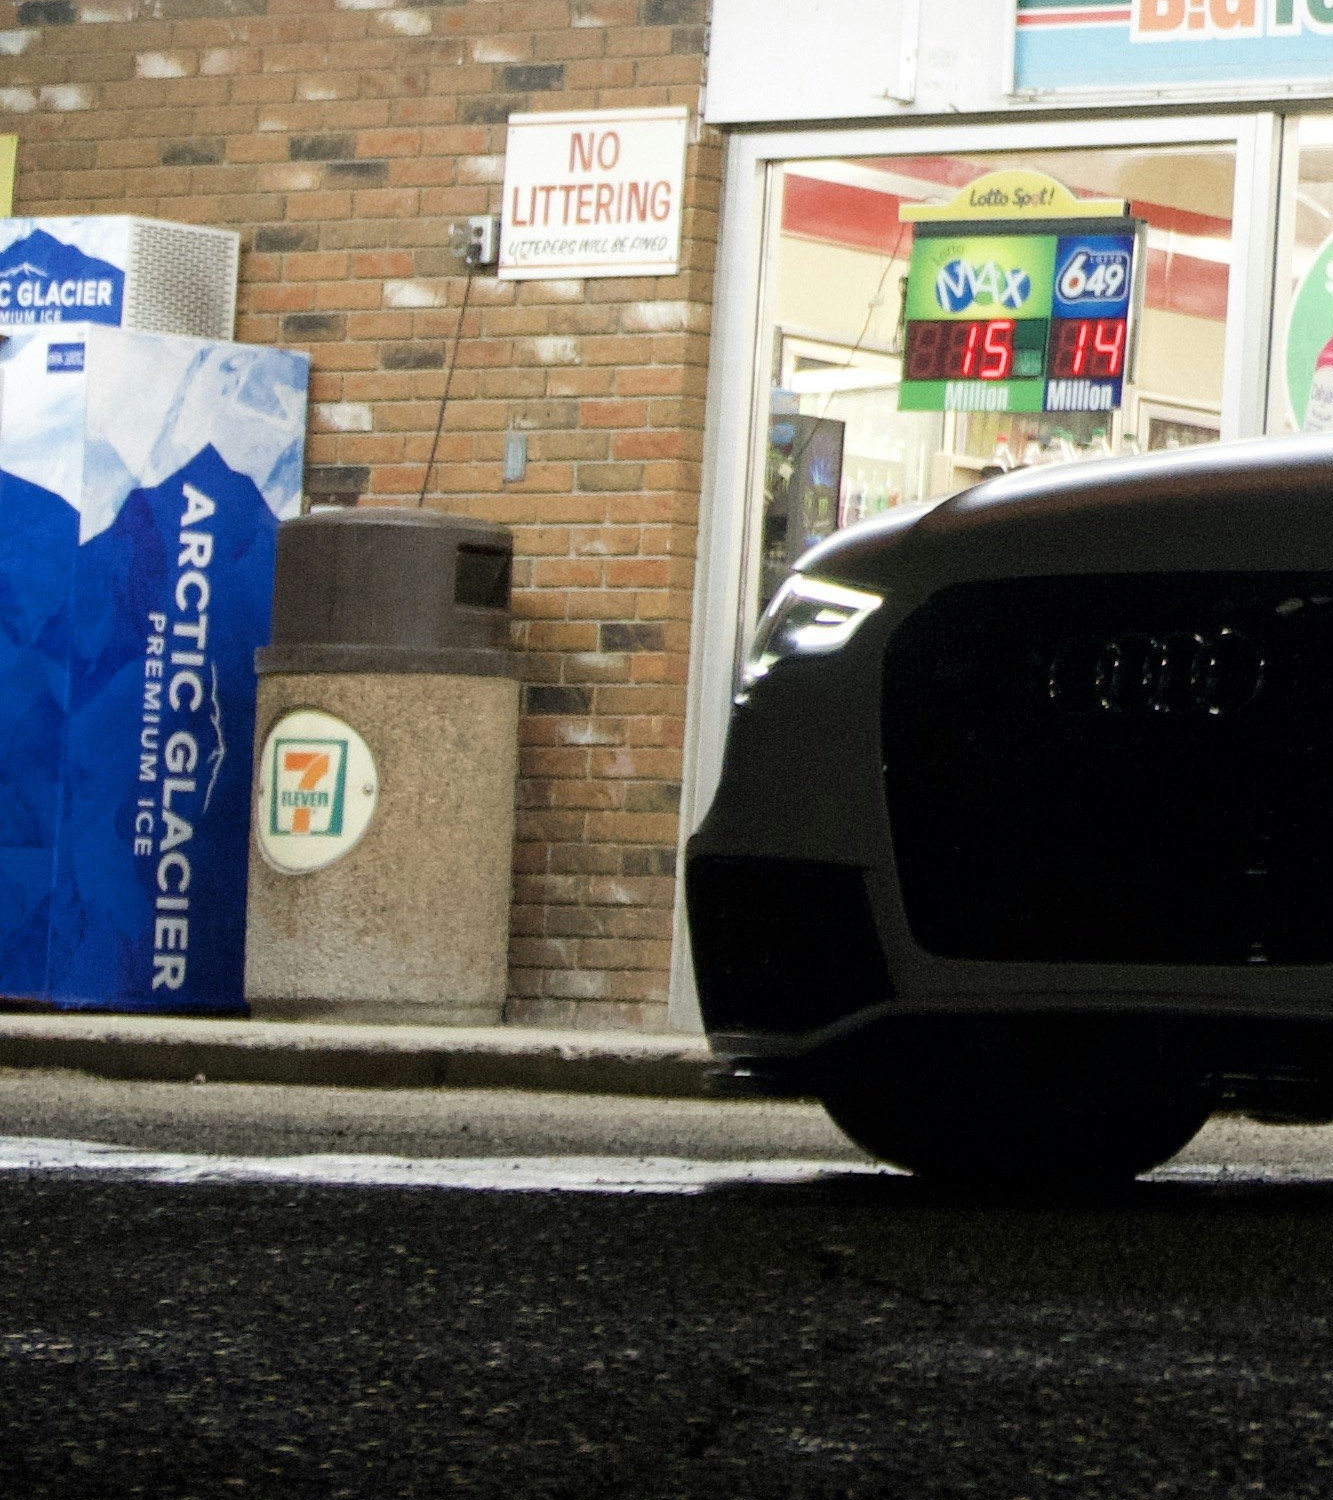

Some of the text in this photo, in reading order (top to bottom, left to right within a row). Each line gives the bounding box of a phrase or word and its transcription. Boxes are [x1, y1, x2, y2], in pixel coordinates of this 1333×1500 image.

[568, 130, 621, 172] NO
[511, 180, 672, 228] LITTERING
[969, 186, 1055, 209] Lotto Spot!
[17, 280, 113, 308] GLACIER
[936, 259, 1031, 314] MAX
[40, 310, 62, 324] ICE
[961, 318, 1015, 380] 15
[1071, 318, 1125, 377] 14
[944, 380, 1009, 411] Million
[1046, 380, 1113, 411] Million
[133, 611, 168, 857] PREMIUM ICE
[152, 482, 217, 991] ARCTIC GLACIER
[284, 752, 330, 833] 7
